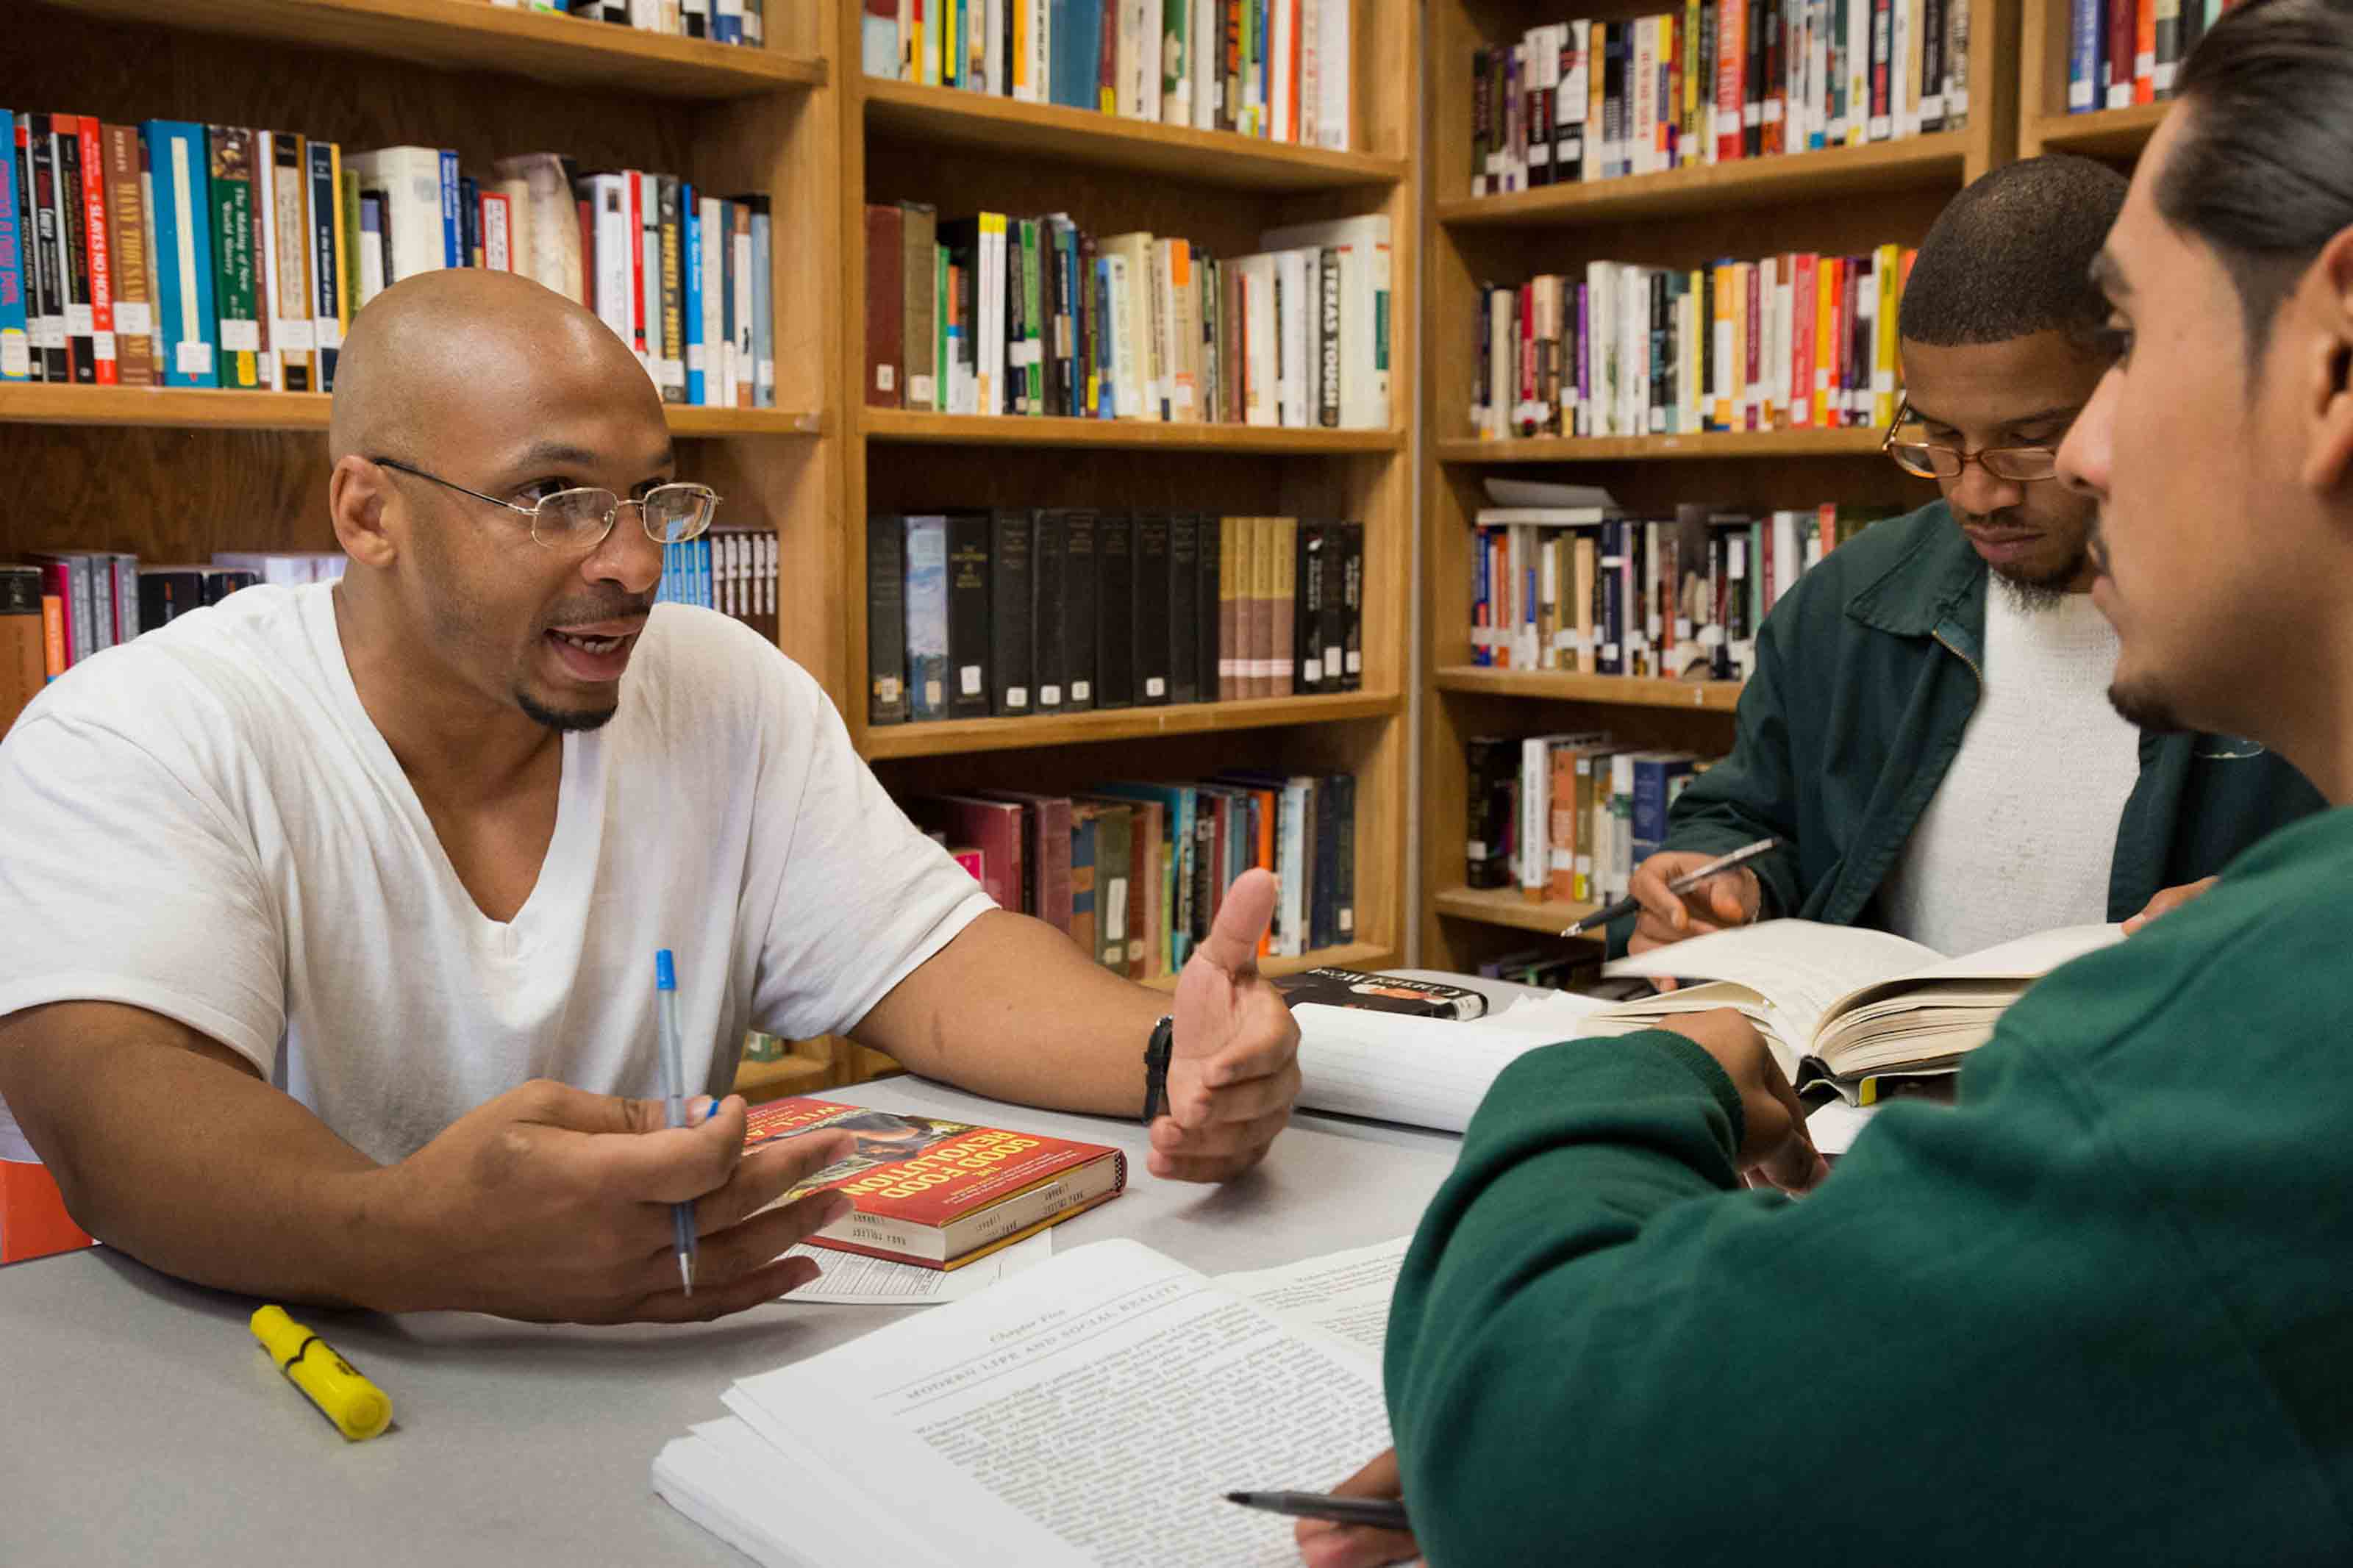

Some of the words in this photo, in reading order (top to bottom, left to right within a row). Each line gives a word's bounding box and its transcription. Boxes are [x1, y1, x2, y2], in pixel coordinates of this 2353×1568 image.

[88, 204, 105, 250] SLAVES
[235, 210, 249, 251] Making
[93, 252, 107, 271] NO
[118, 229, 146, 302] THOUSAN
[239, 268, 251, 293] New
[96, 273, 110, 309] MORE
[1322, 267, 1339, 333] TEXAS
[1322, 339, 1339, 407] TOUGH
[838, 1130, 1019, 1197] REVOLUTION
[957, 1139, 1042, 1169] GOOD
[879, 1167, 969, 1200] FOOD
